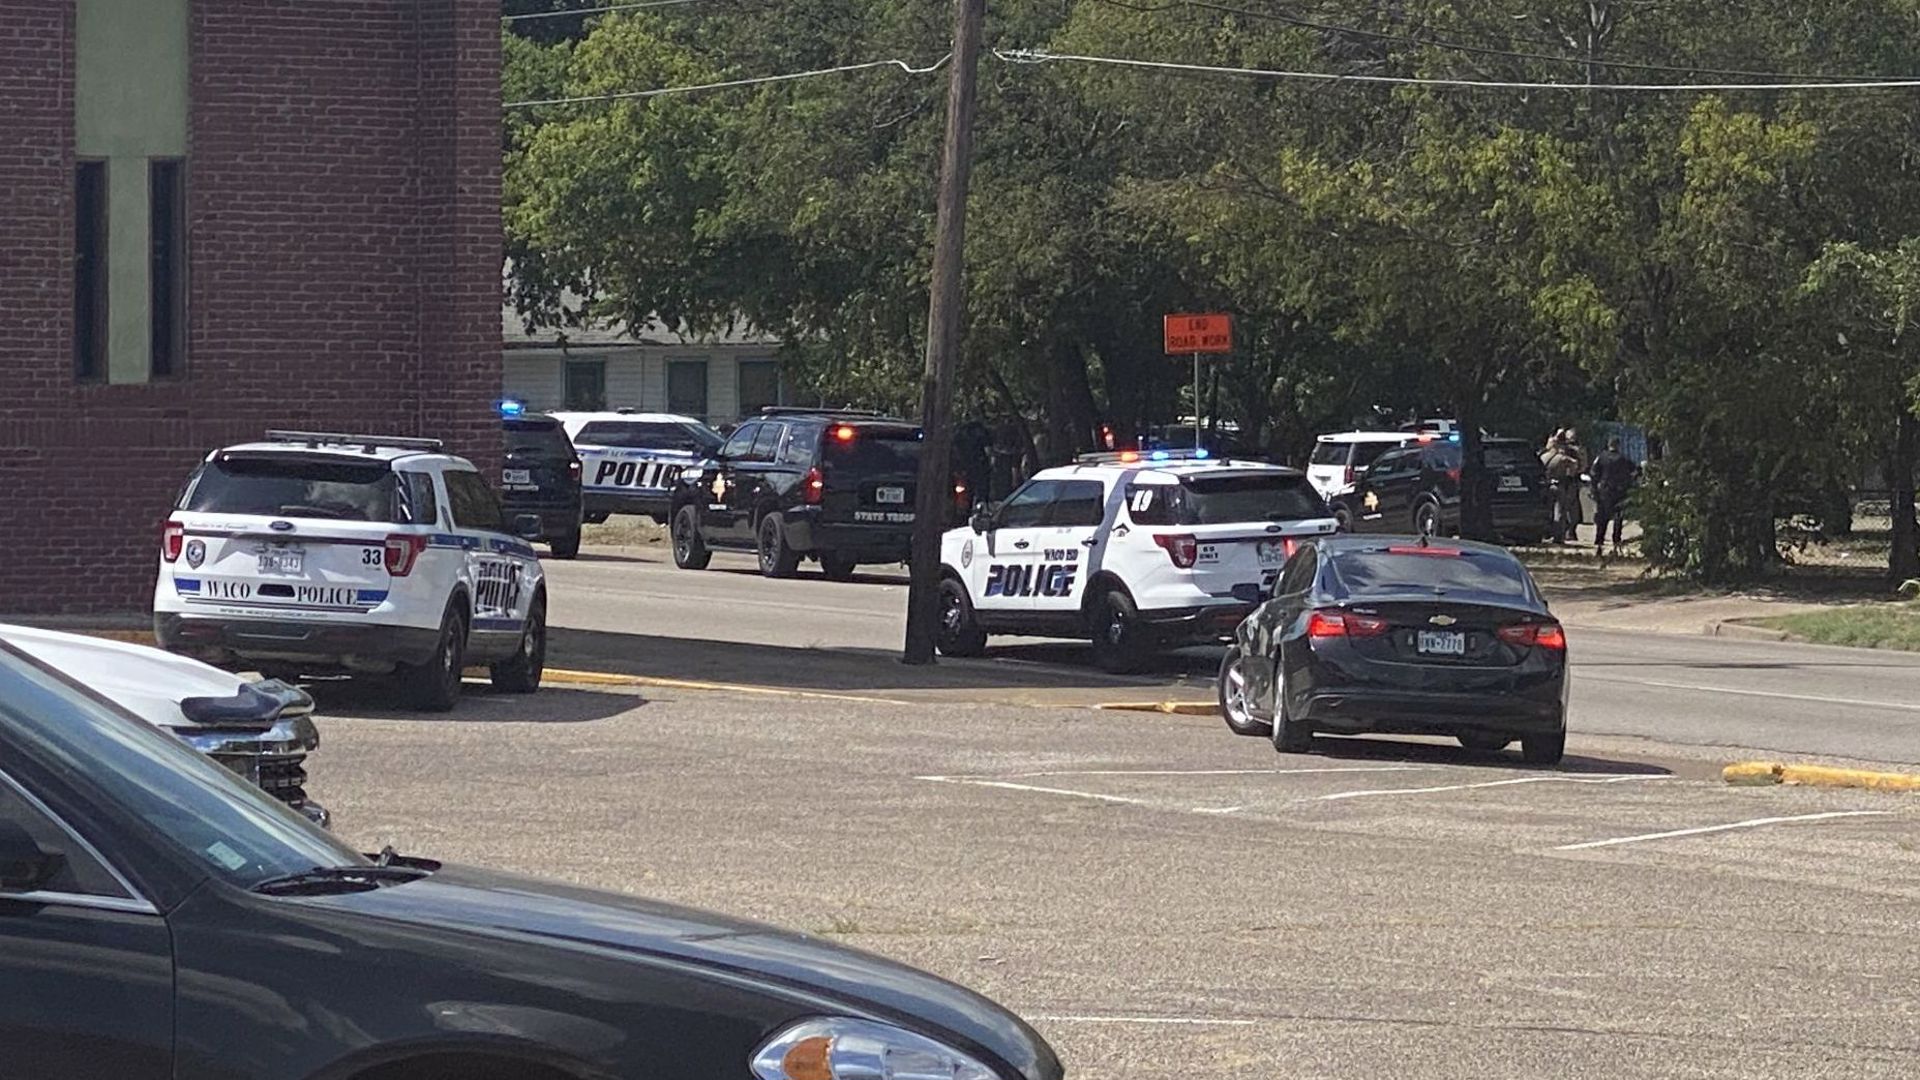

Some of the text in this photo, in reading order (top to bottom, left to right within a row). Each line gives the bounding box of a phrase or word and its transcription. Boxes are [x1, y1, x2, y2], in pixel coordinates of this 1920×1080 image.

[1169, 334, 1228, 348] ROAD WORK
[593, 461, 683, 489] POLIC
[854, 511, 885, 521] STATE
[361, 548, 382, 566] 33
[1044, 548, 1065, 561] WACO
[984, 564, 1079, 597] POLICE
[206, 580, 359, 606] WACO POLICE
